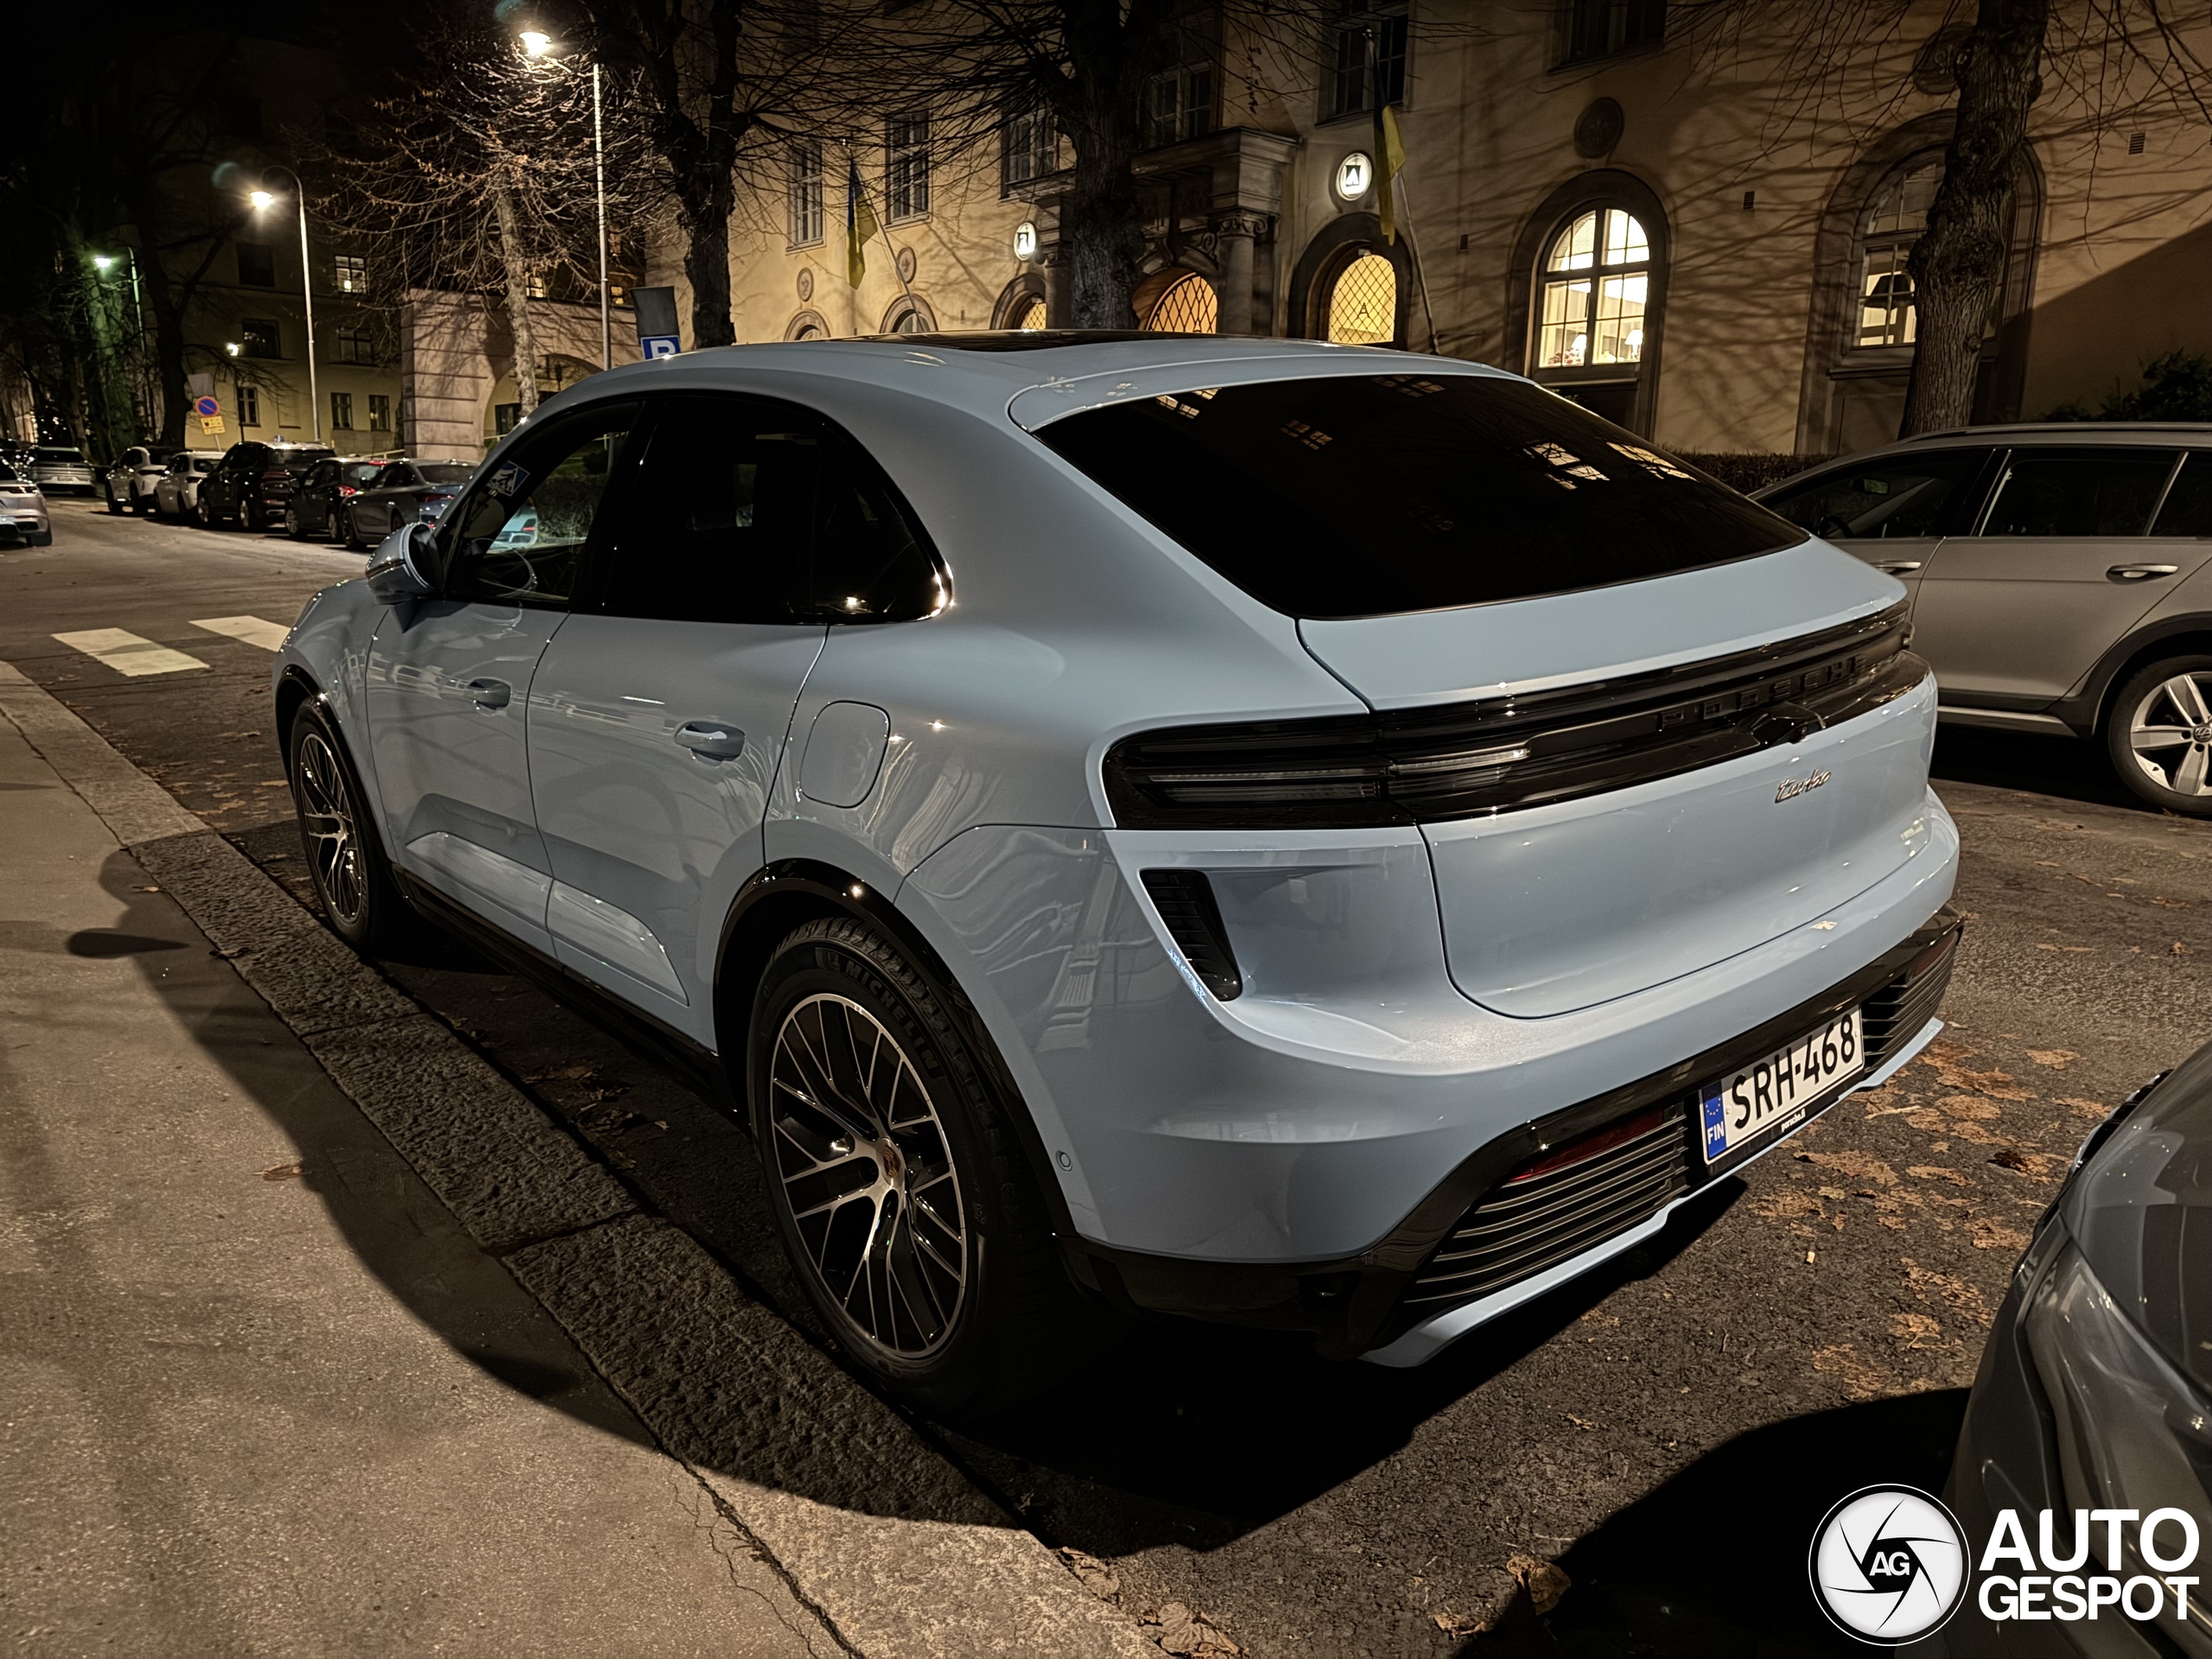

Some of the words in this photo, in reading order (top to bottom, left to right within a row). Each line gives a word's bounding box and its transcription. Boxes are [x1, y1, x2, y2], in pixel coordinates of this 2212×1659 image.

[1656, 653, 1868, 732] PORSCHE
[1775, 768, 1832, 804] turbo
[844, 960, 939, 1070] MICHELIN
[1731, 1013, 1856, 1130] SRH-468
[1707, 1121, 1725, 1146] FIN
